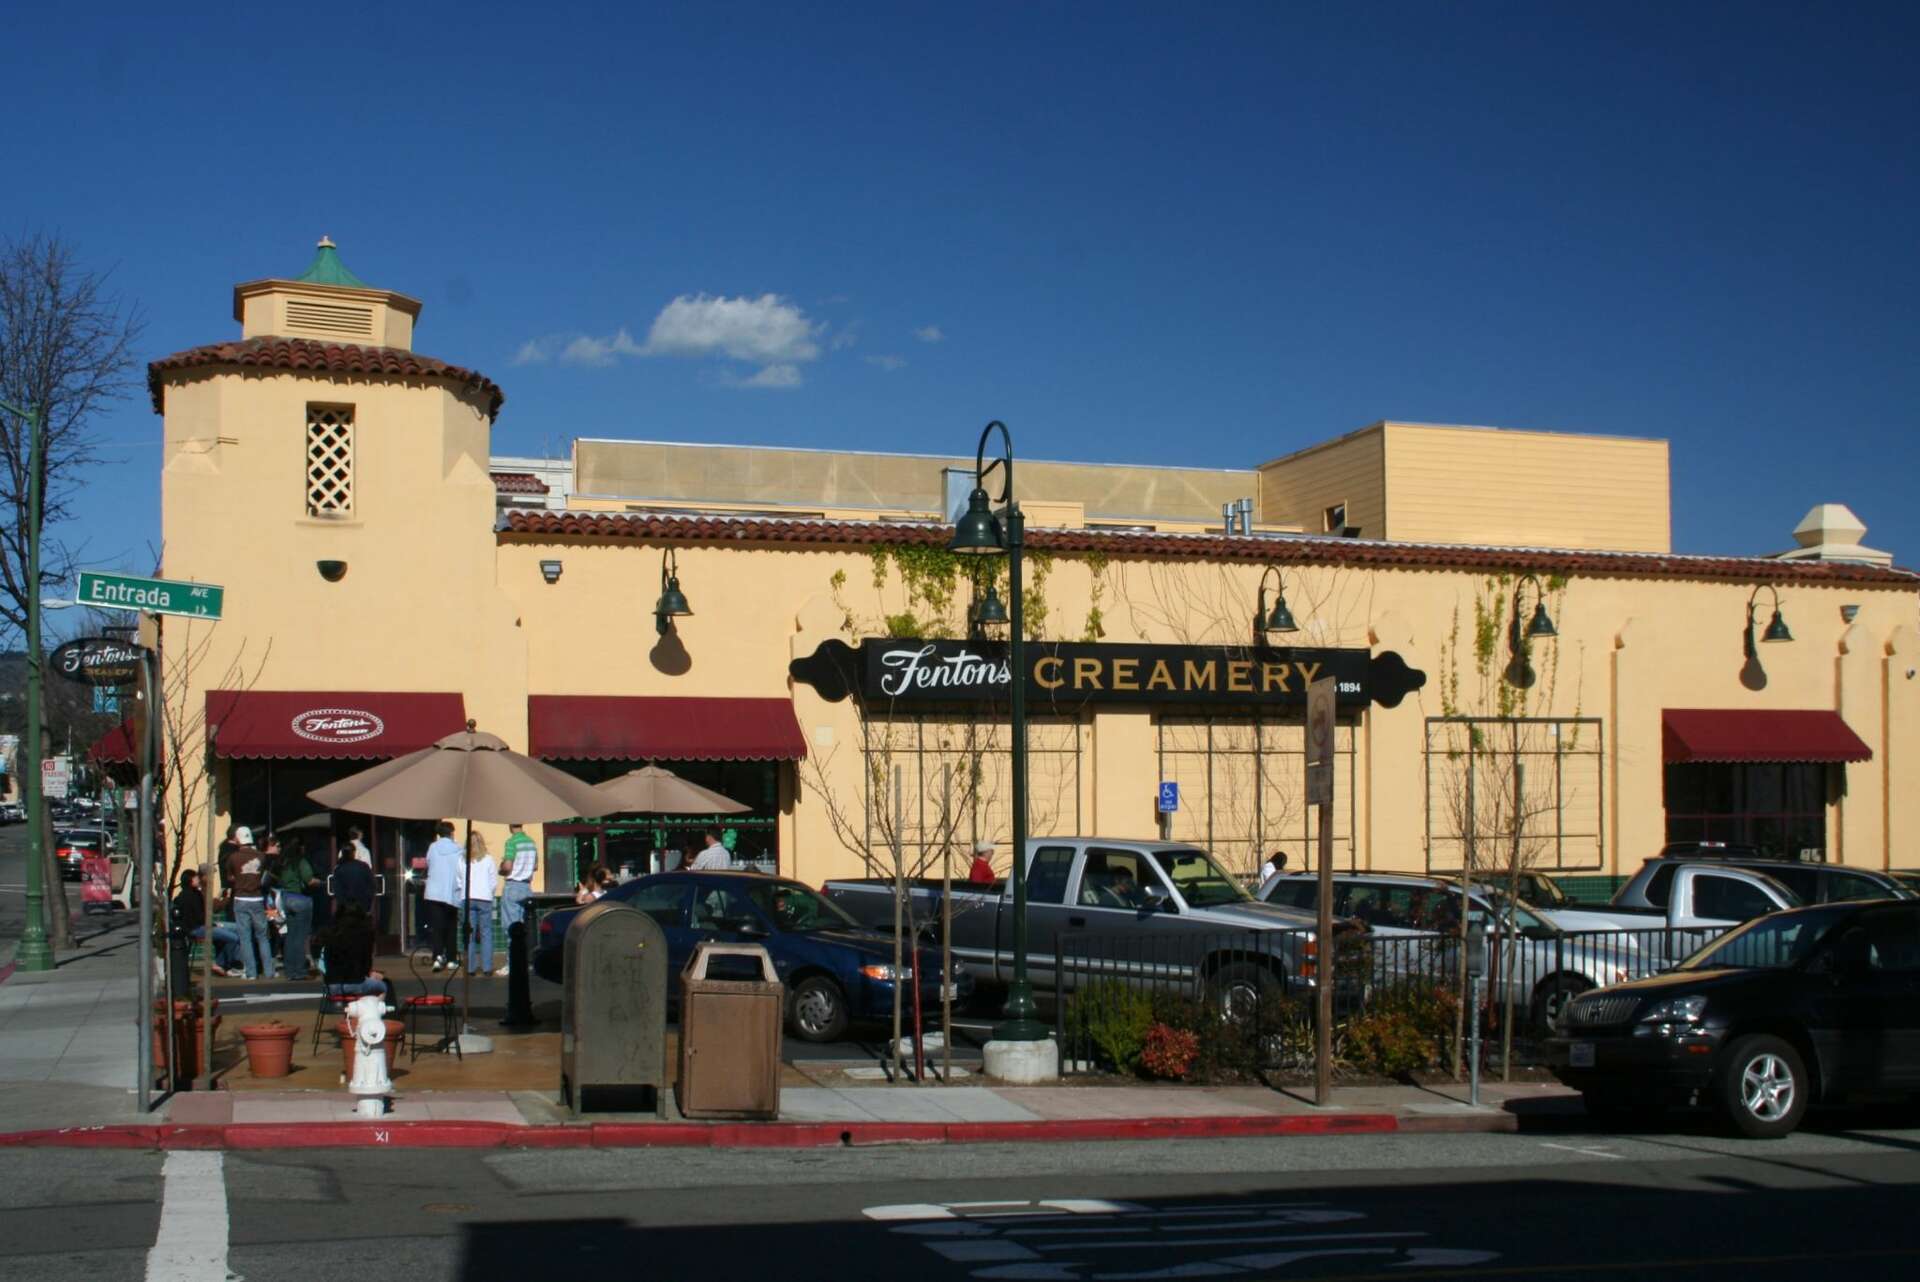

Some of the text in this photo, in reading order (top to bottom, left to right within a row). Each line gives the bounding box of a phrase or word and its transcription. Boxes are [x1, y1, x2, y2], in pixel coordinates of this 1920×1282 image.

[91, 579, 171, 607] Entrada
[190, 587, 209, 598] AVE
[64, 645, 139, 672] Fentons
[881, 644, 1322, 696] Fentons CREAMERY
[1338, 682, 1361, 693] 1894
[305, 718, 371, 732] Fentons
